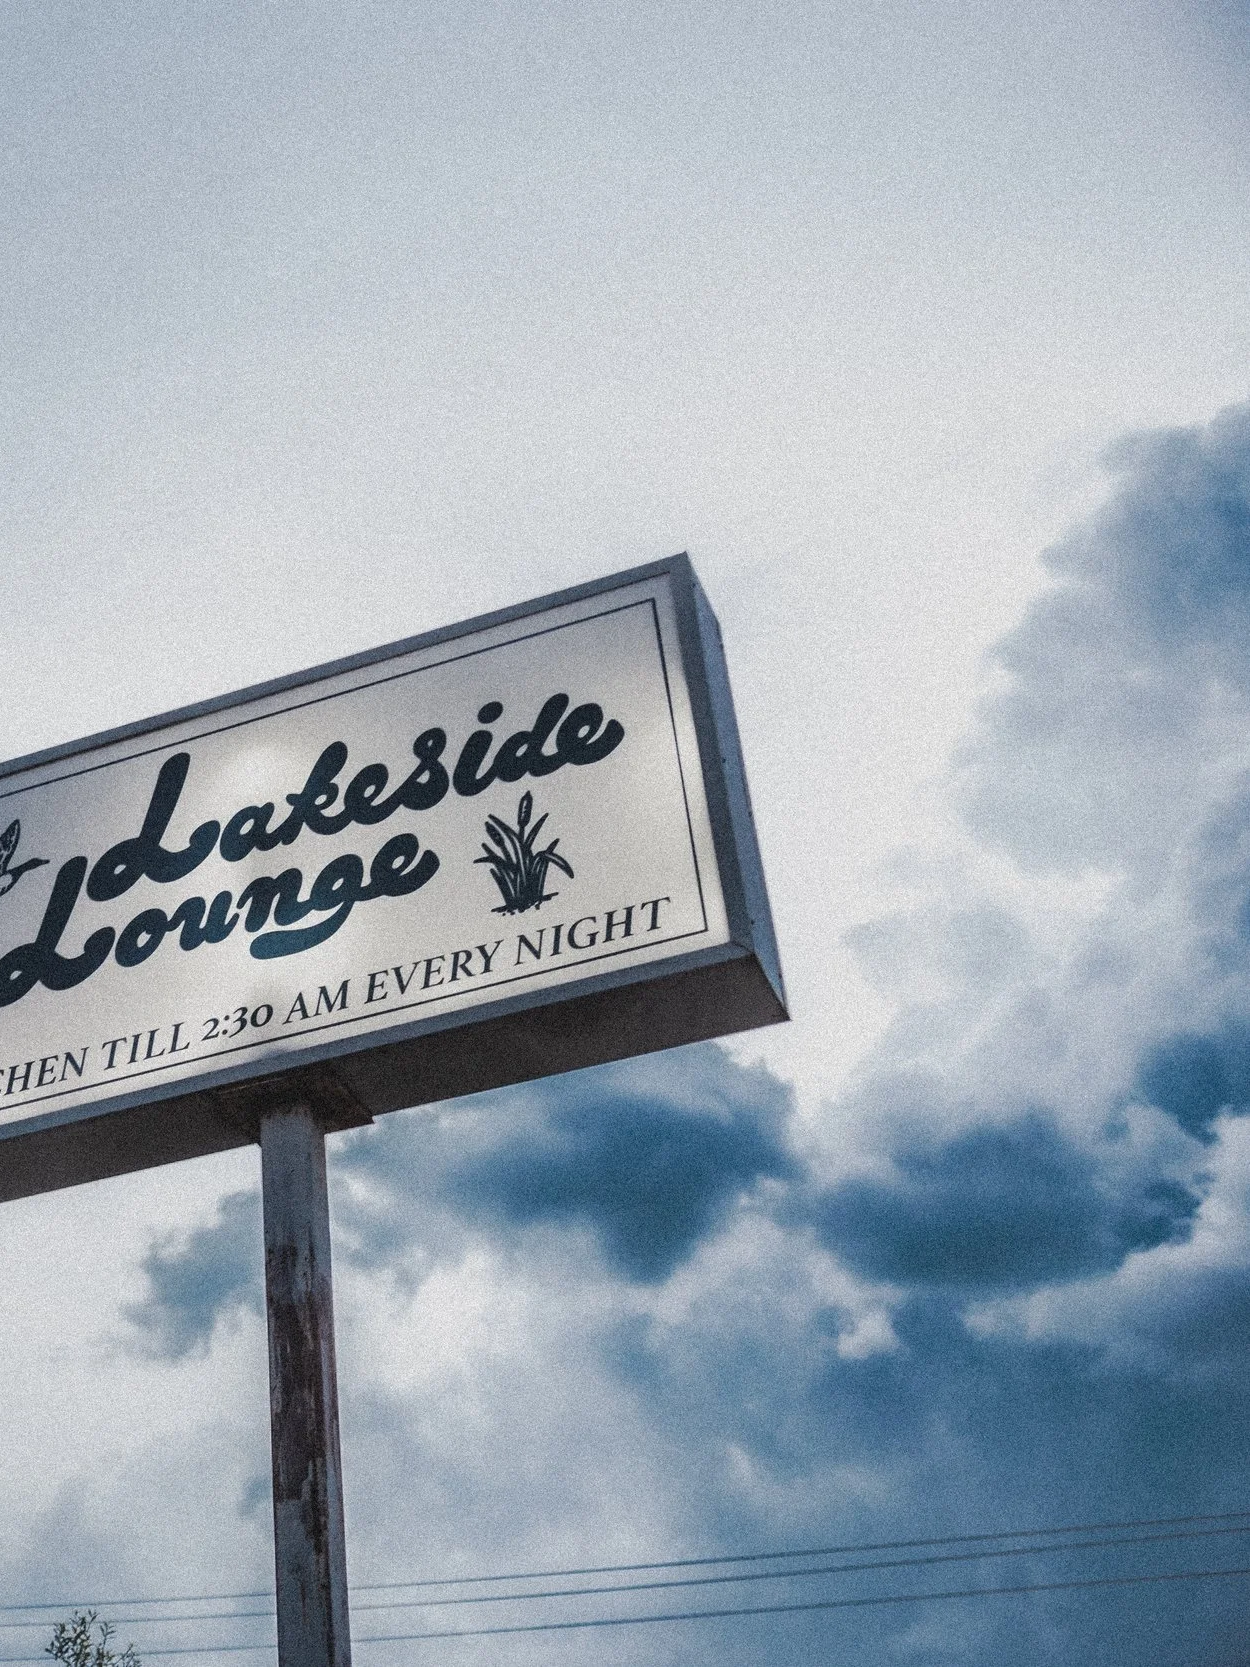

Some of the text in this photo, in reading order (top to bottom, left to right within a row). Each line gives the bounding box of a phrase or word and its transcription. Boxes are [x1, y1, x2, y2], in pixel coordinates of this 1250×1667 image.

[86, 692, 625, 902] Lakeside
[100, 1022, 190, 1070] TILL
[201, 1001, 275, 1042] 2:30
[283, 979, 352, 1024] AM
[364, 941, 505, 1004] EVERY
[514, 896, 672, 962] NIGHT
